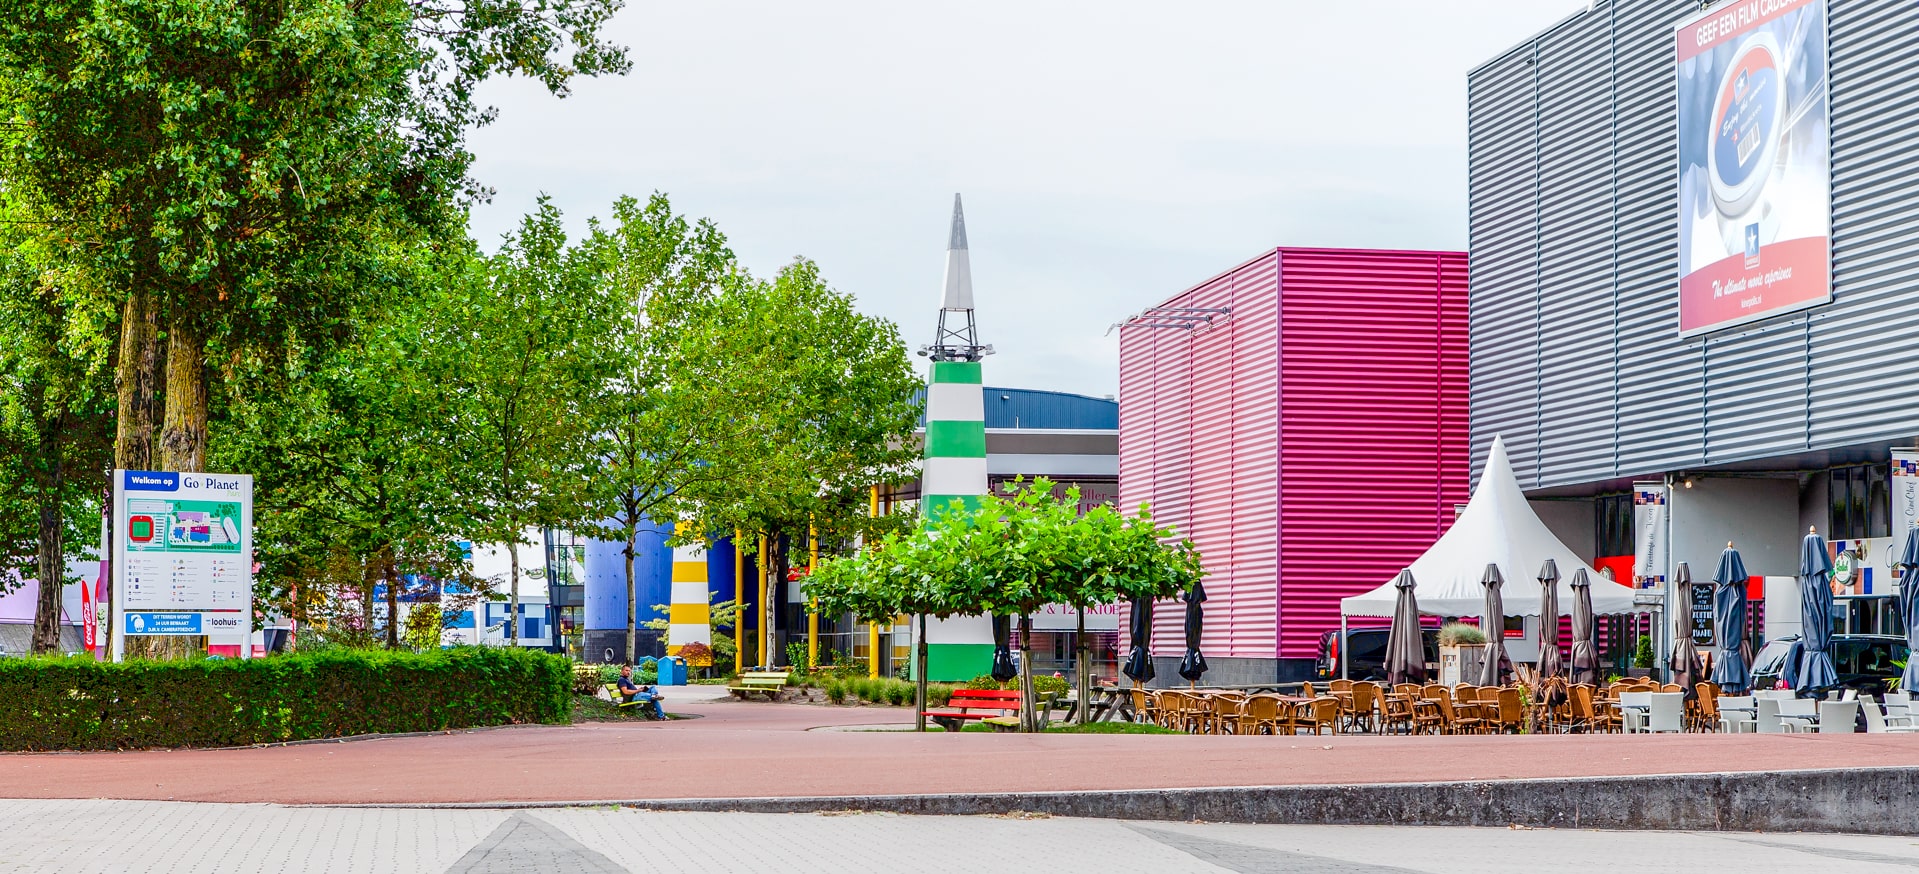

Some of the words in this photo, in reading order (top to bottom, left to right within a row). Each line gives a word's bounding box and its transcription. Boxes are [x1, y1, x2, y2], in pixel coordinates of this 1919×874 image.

[1696, 20, 1718, 47] GEEF
[1720, 12, 1736, 37] EEN
[1738, 0, 1759, 28] FILM
[1712, 280, 1723, 299] The
[1723, 277, 1747, 295] ultimate
[1748, 272, 1763, 288] movie
[1764, 267, 1792, 288] experience
[131, 476, 162, 485] Welkom
[163, 478, 174, 487] op
[184, 477, 199, 489] Go
[205, 477, 240, 490] Planet
[1062, 604, 1076, 615] 12
[211, 617, 237, 626] loohuis
